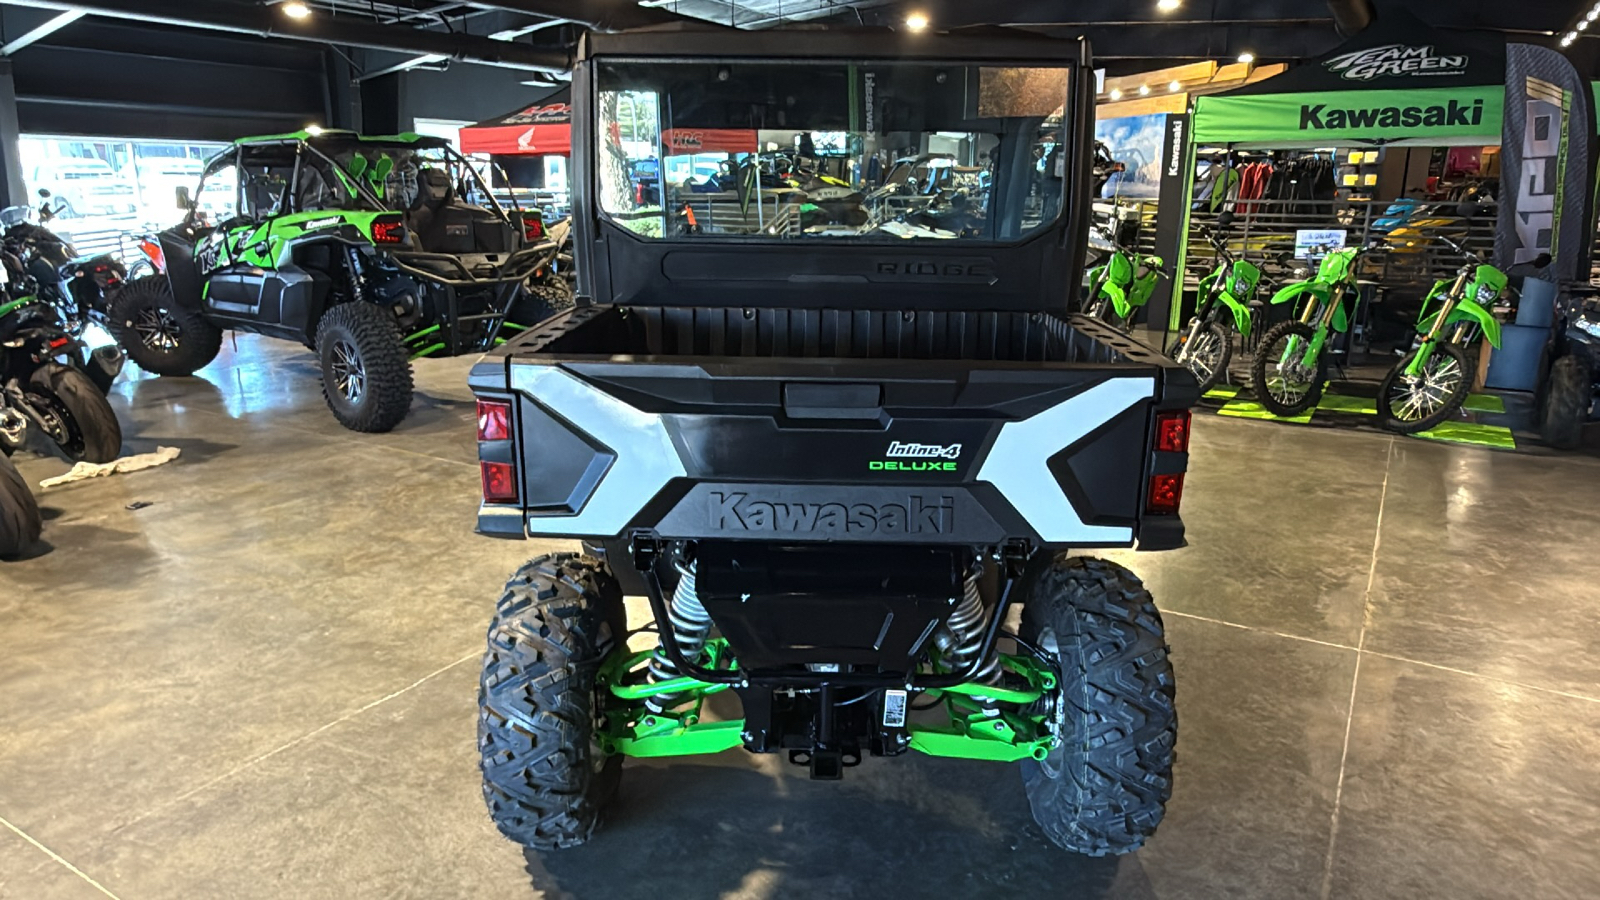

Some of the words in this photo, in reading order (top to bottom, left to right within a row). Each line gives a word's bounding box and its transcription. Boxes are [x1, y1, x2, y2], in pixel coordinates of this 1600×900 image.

[1322, 44, 1432, 69] TEAM
[1342, 55, 1467, 80] GREEN
[1299, 99, 1484, 130] Kawasaki
[673, 131, 703, 148] HRC
[1168, 121, 1182, 176] Kawasaki
[877, 262, 988, 276] RIDGE
[886, 441, 962, 458] Inline-4
[869, 461, 957, 471] DELUXE
[709, 491, 954, 534] Kawasaki
